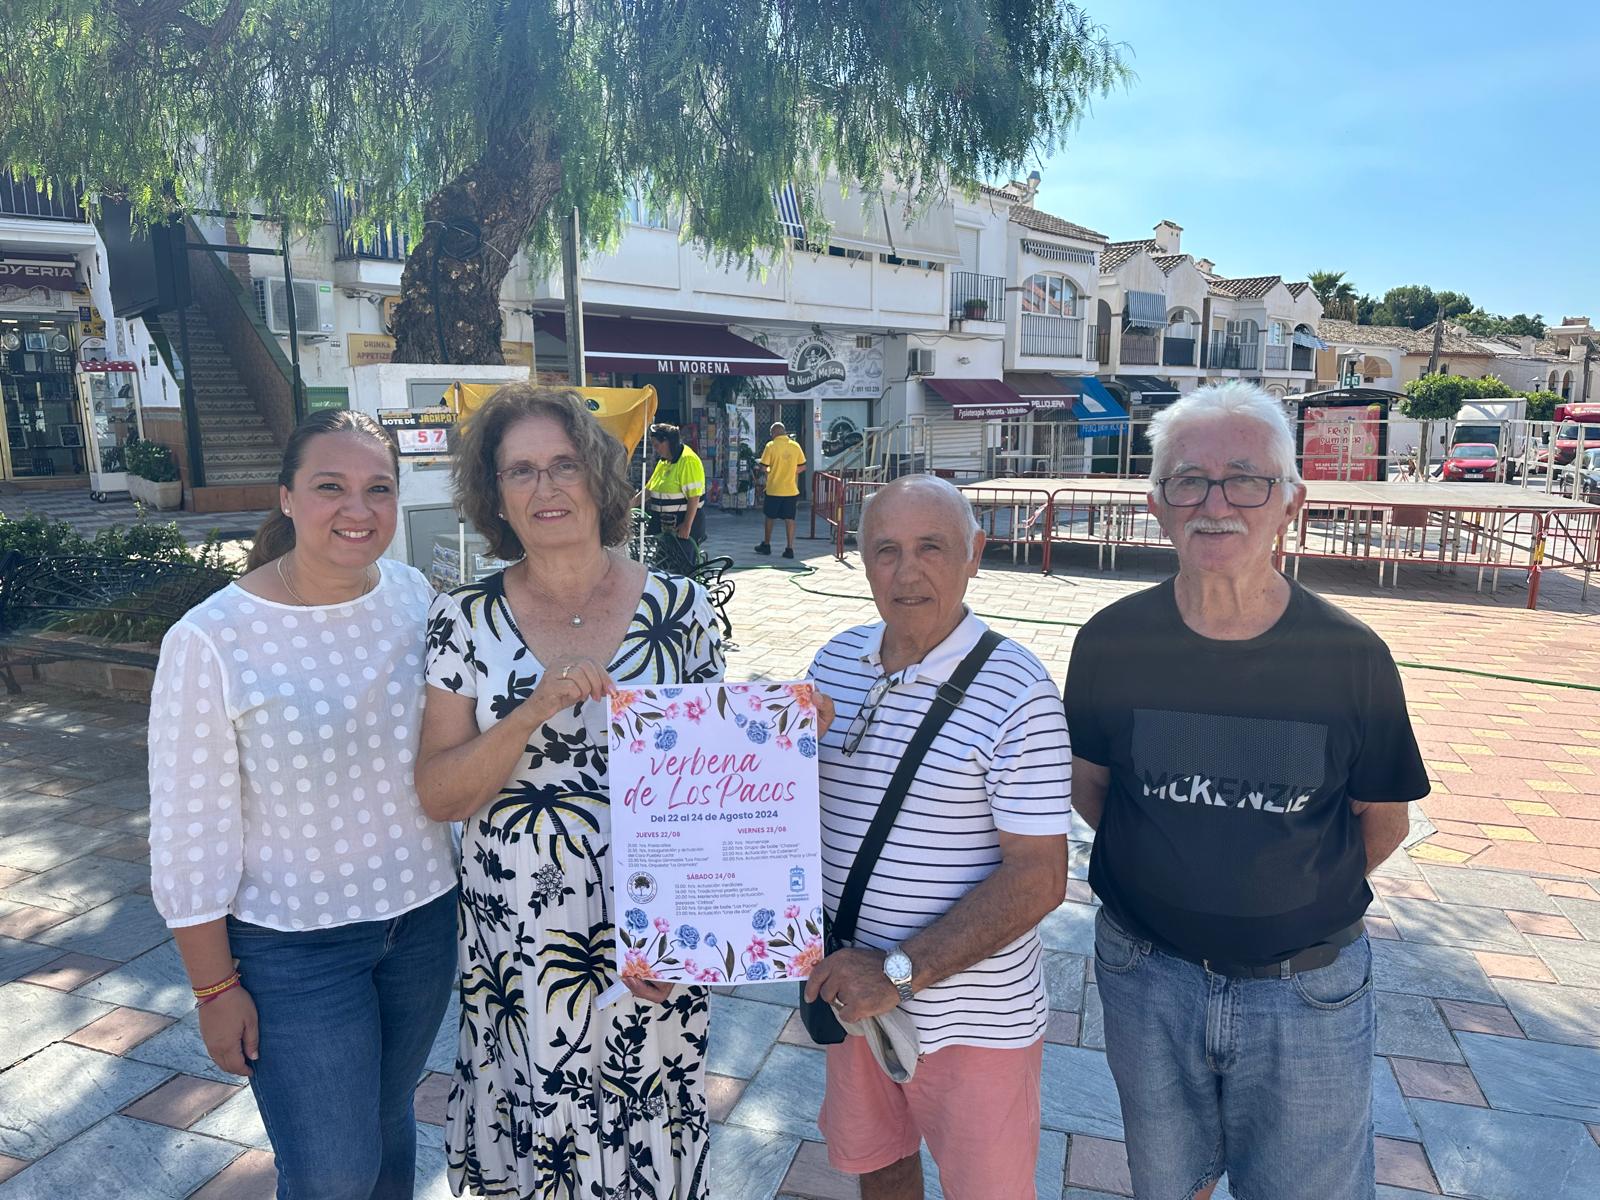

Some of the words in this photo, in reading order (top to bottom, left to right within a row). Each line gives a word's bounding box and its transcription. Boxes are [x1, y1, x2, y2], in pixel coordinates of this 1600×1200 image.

[792, 339, 808, 369] PIZZERIA
[658, 360, 674, 372] MI
[680, 361, 730, 374] MORENA
[787, 376, 795, 385] La
[797, 373, 817, 386] Nueva
[624, 776, 656, 814] de
[668, 776, 712, 810] Los
[716, 774, 796, 808] Pacos
[651, 814, 666, 822] Del
[668, 814, 679, 822] 22
[680, 813, 690, 821] al
[705, 812, 717, 821] de
[719, 812, 753, 823] Agosto
[755, 810, 778, 819] 2024
[686, 872, 714, 880] SÁBADO
